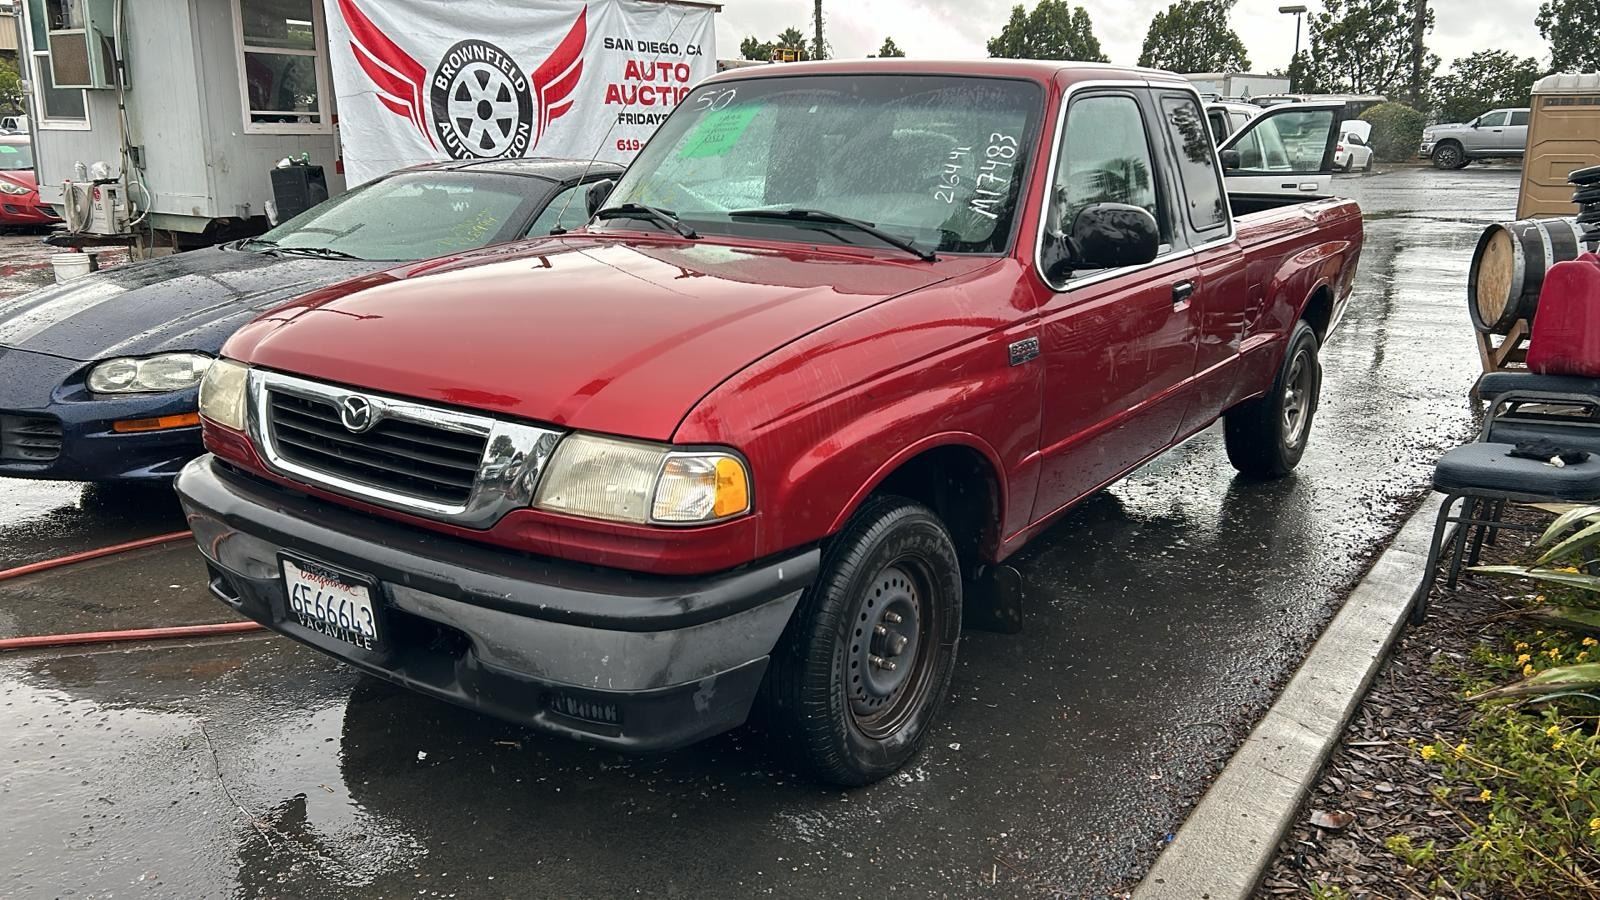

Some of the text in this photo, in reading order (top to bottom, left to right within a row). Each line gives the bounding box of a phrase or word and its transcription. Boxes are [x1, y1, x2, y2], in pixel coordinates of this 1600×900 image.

[604, 37, 703, 56] SAN DIEGO, CA
[435, 45, 526, 92] BROWNFIELD
[623, 60, 691, 84] AUTO
[693, 88, 738, 112] 50
[438, 121, 475, 160] AUTO
[967, 132, 1018, 220] M17483
[94, 202, 103, 210] LG
[291, 582, 376, 640] 6E66643
[297, 612, 373, 652] VACAVILLE
